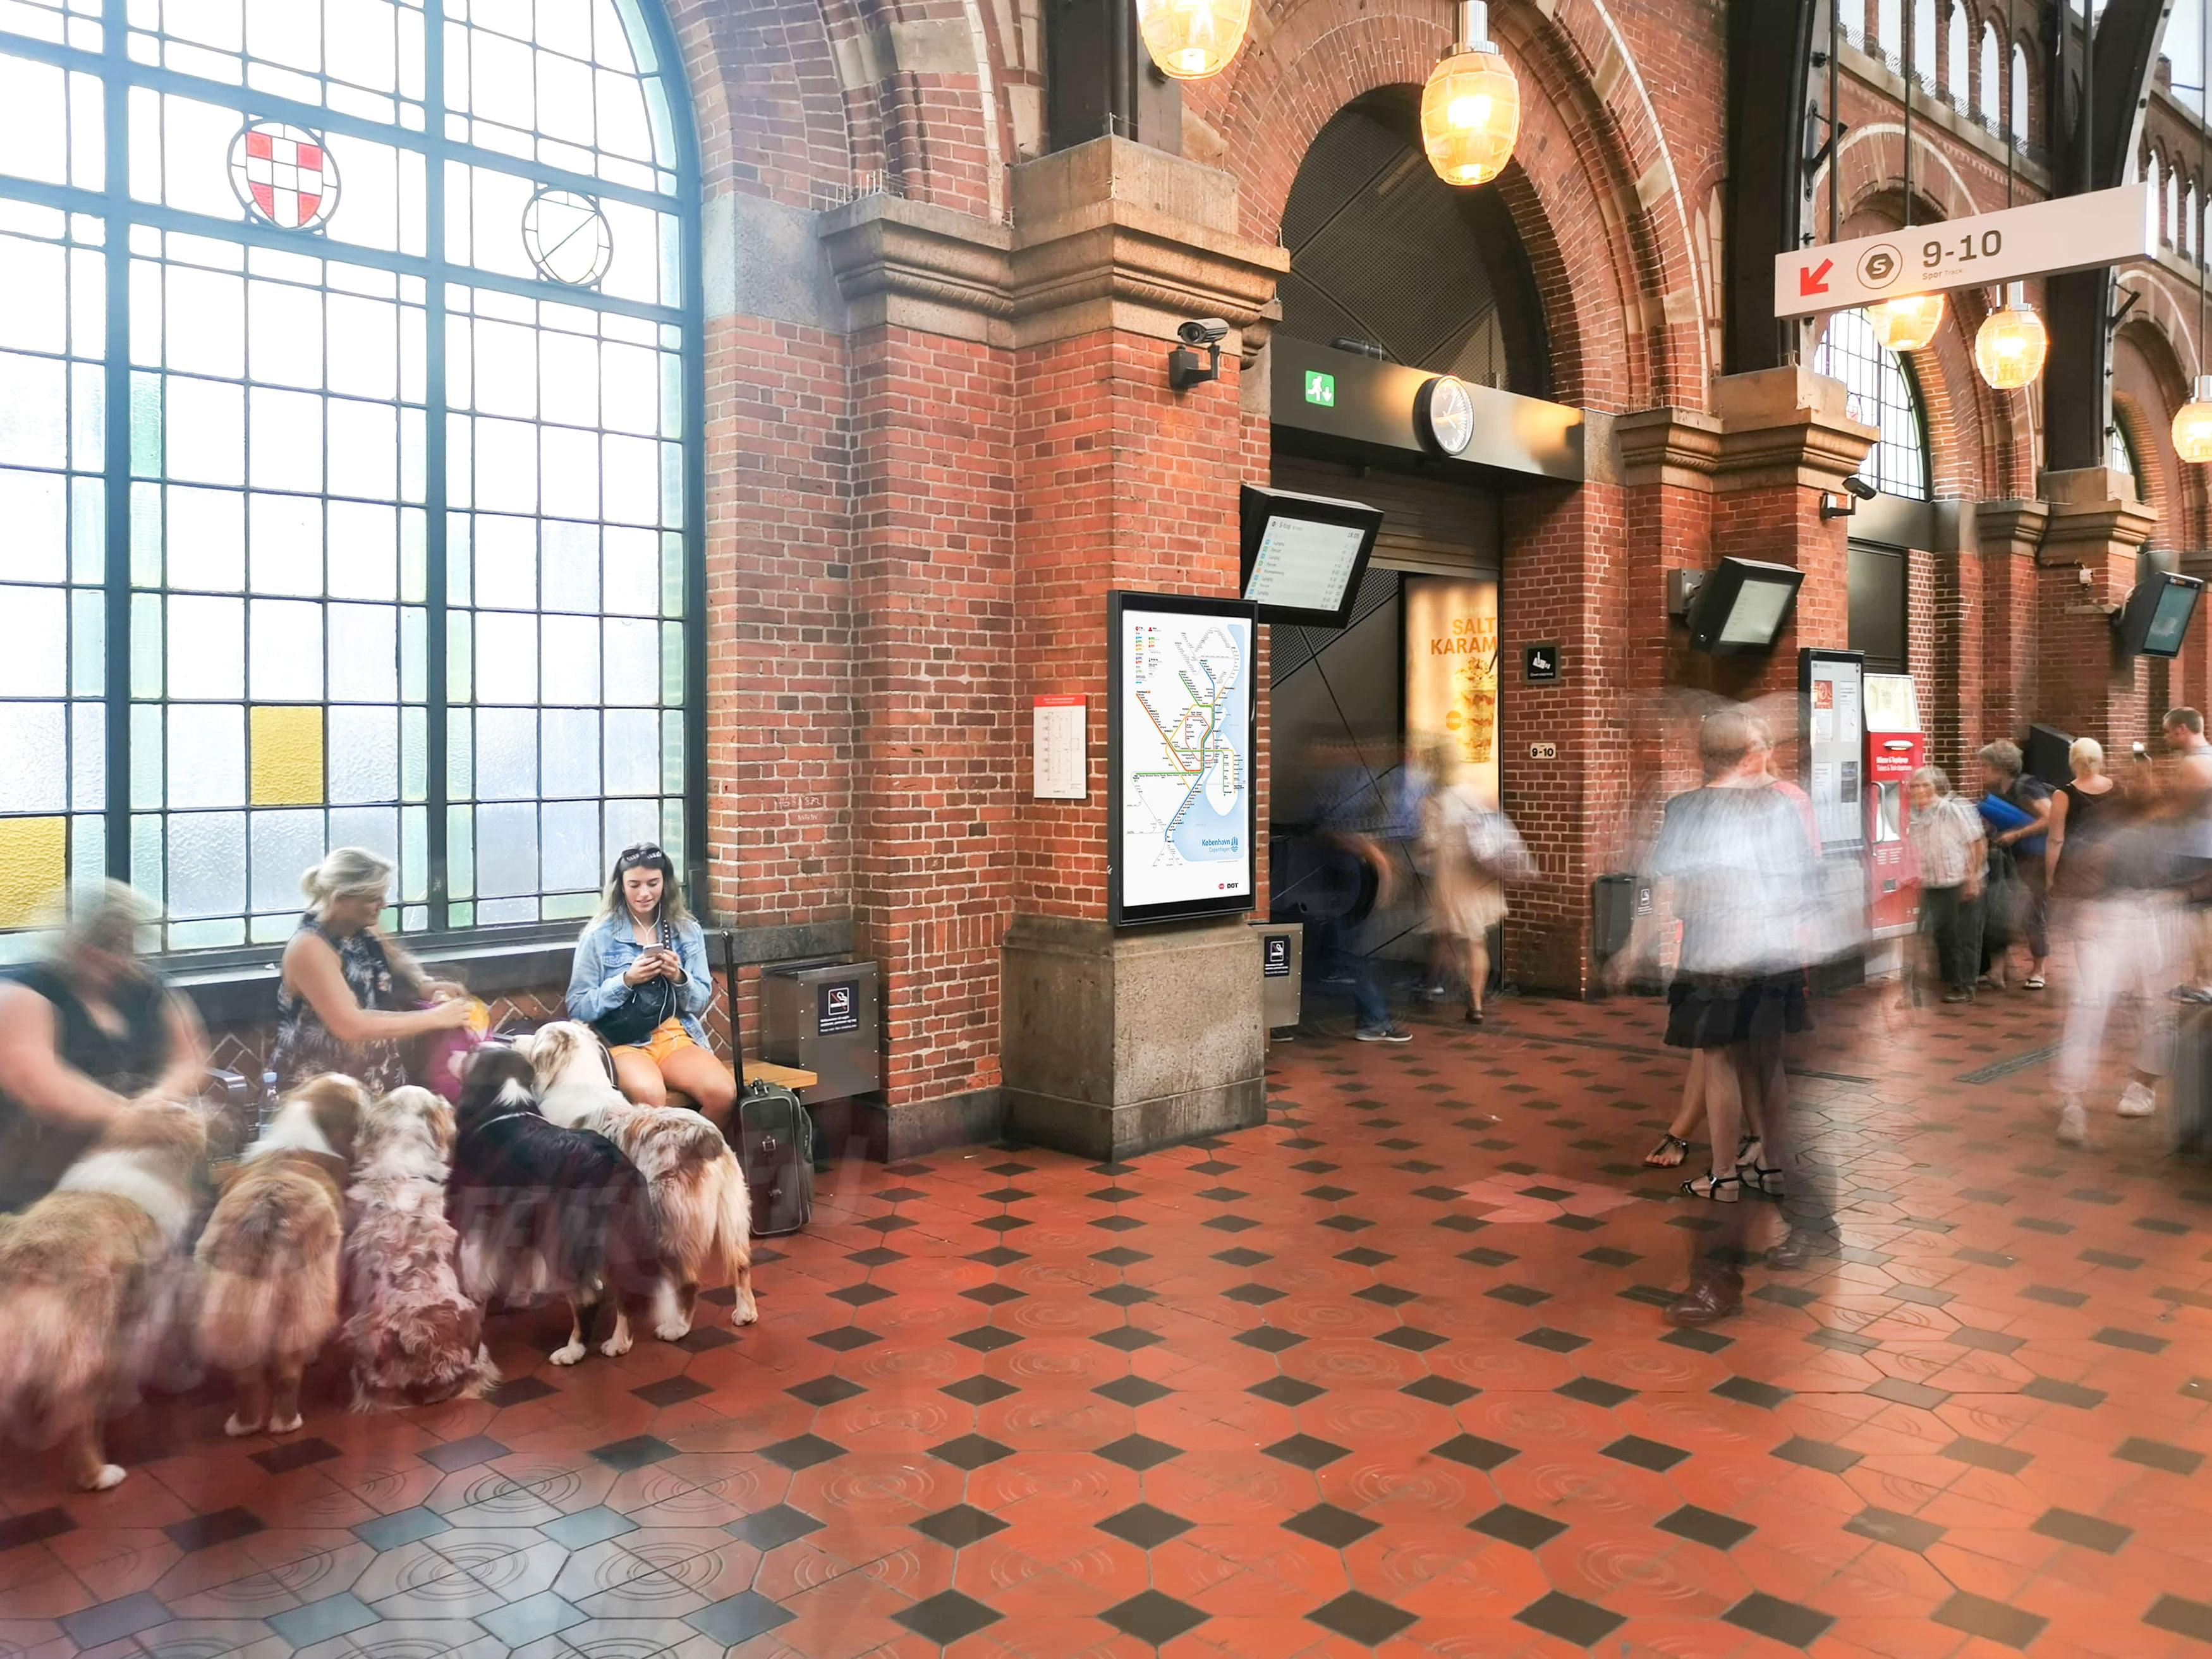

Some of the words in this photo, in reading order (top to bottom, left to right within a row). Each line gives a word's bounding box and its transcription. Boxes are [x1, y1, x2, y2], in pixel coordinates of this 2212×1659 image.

[1923, 230, 2002, 268] 9-10
[1922, 271, 1943, 281] Spor
[1453, 617, 1496, 635] SALT
[1431, 636, 1497, 655] KARAM
[1532, 748, 1553, 757] 9-10
[1202, 838, 1231, 846] København
